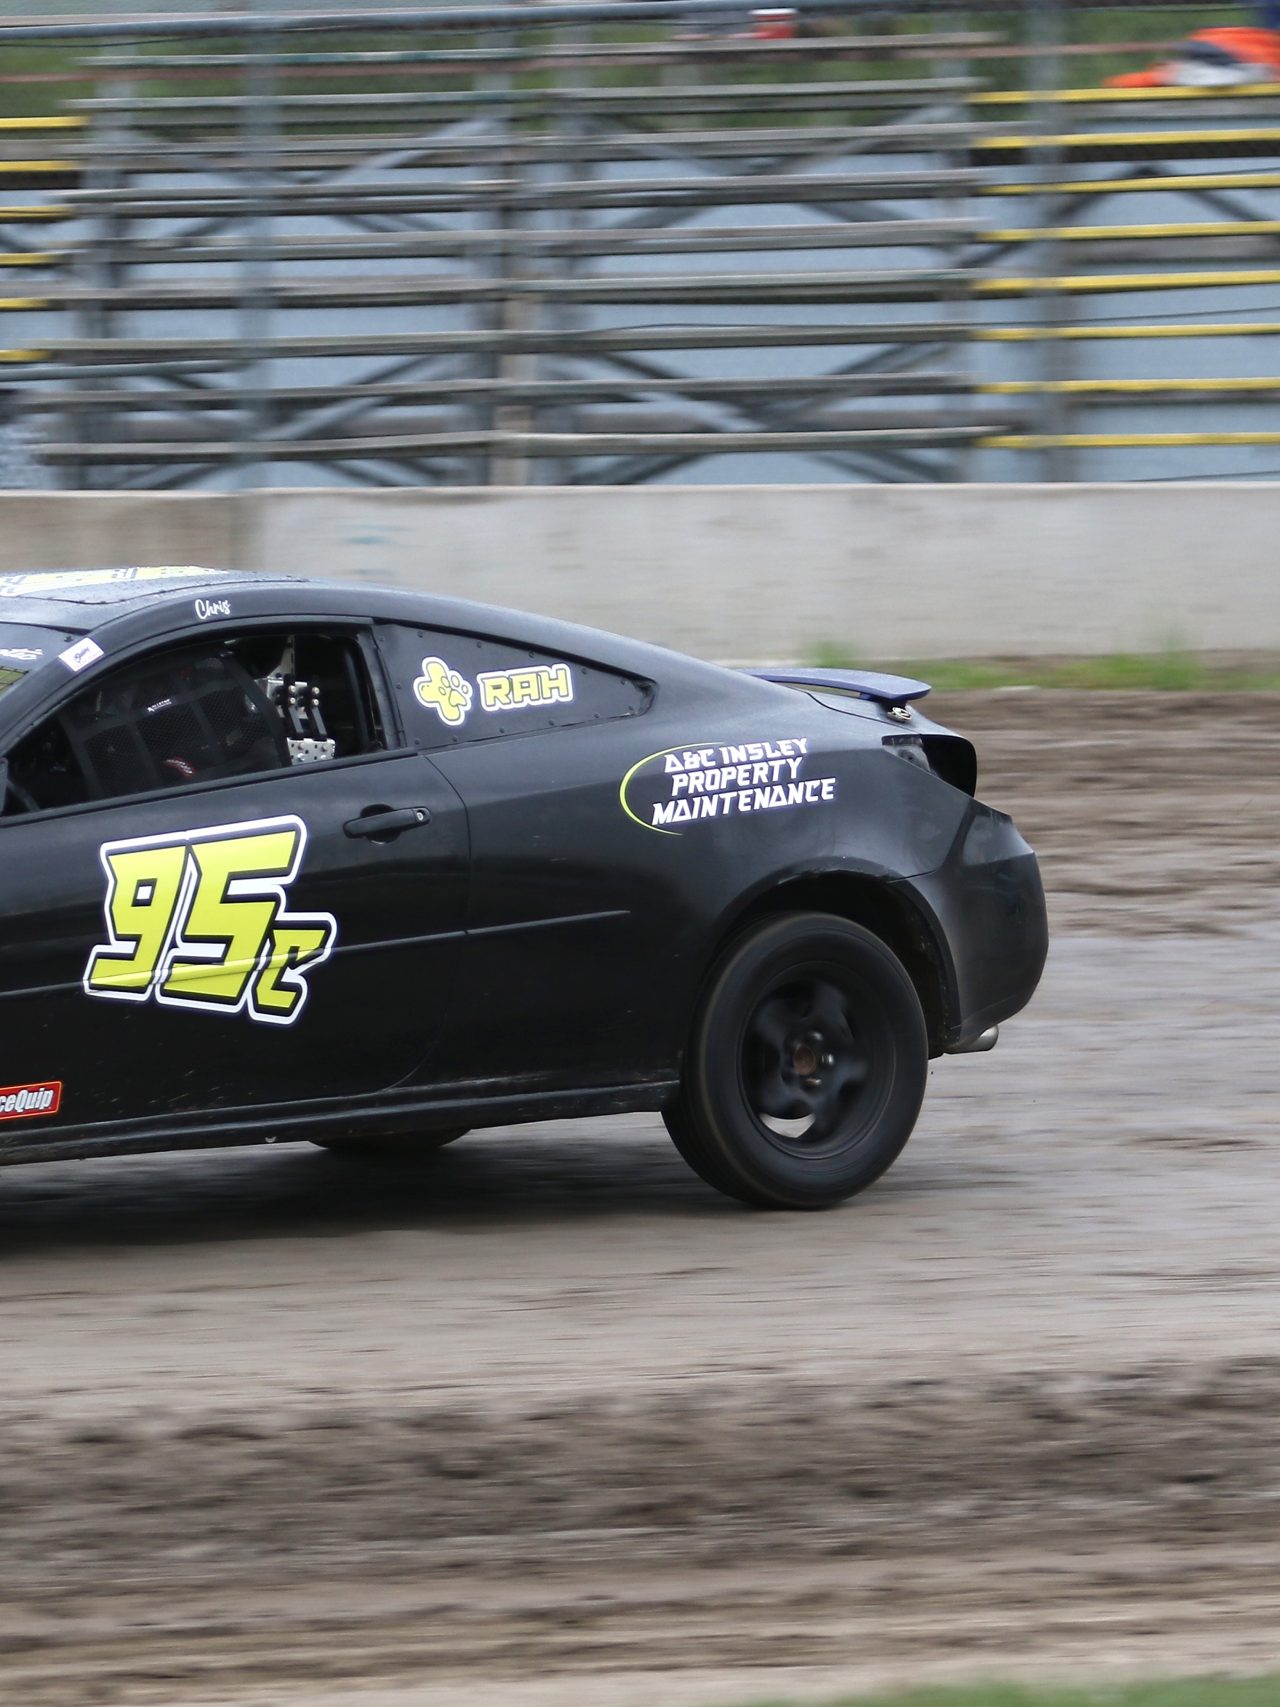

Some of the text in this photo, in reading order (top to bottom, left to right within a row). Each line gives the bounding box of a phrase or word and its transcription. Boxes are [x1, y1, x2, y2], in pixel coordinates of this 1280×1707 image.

[195, 599, 231, 620] Chris
[479, 665, 571, 709] RAH
[664, 737, 808, 774] A&C INSLEY
[671, 756, 803, 797] PROPERTY
[651, 777, 836, 826] MAINTENANCE
